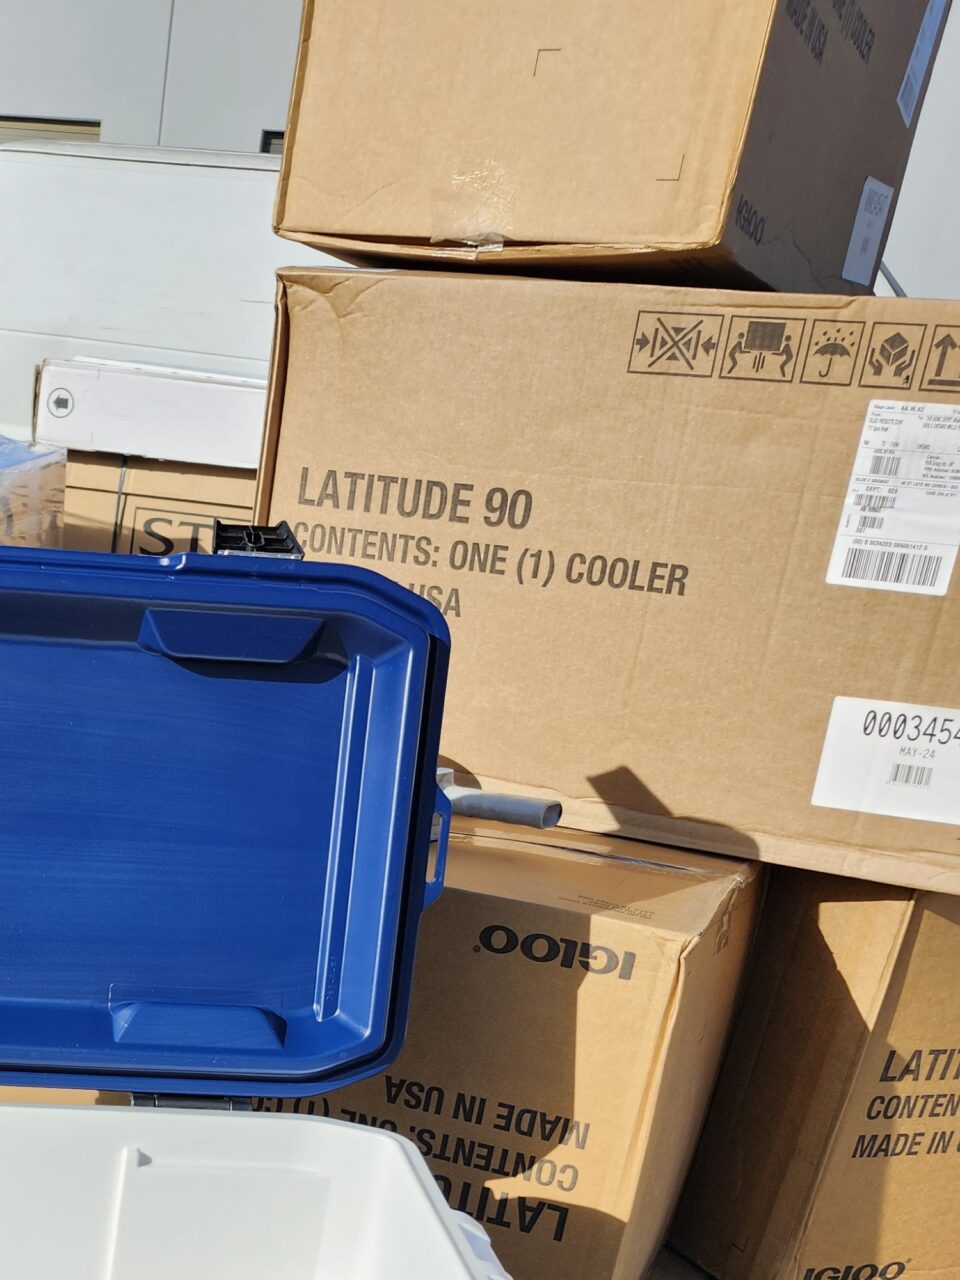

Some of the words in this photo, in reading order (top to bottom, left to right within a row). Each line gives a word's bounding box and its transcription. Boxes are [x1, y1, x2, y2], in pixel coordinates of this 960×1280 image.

[297, 467, 474, 524] LATITUDE
[483, 486, 533, 530] 90
[293, 521, 441, 568] CONTENTS:
[449, 540, 509, 576] ONE
[516, 547, 556, 588] (1)
[565, 552, 689, 596] COOLER
[899, 746, 936, 760] MAY-24
[384, 1075, 445, 1115] USA
[453, 1092, 487, 1125] IN
[493, 1102, 591, 1150] MADE
[851, 1132, 926, 1158] MADE
[926, 1130, 955, 1155] IN
